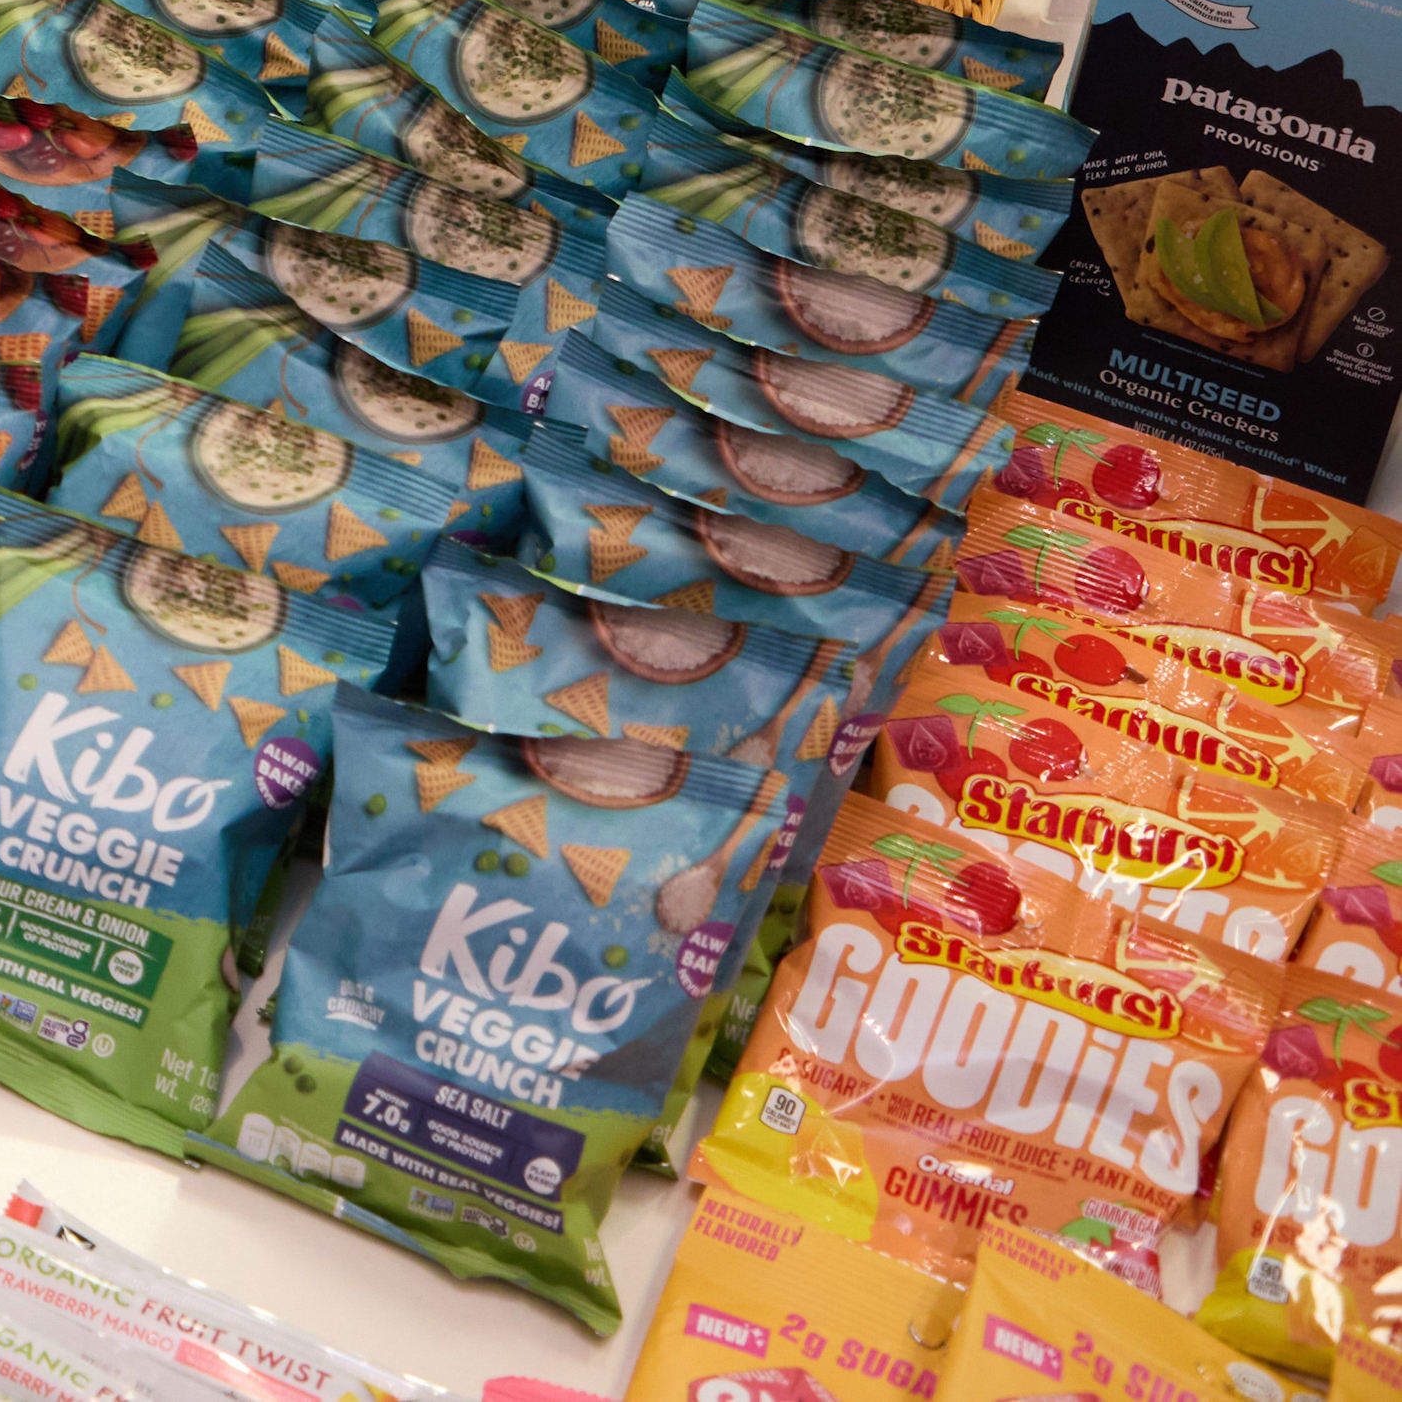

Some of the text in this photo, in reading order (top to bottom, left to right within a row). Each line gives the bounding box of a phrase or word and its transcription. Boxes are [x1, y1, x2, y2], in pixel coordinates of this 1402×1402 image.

[1160, 76, 1377, 163] patagonia
[1203, 123, 1321, 172] PROVISIONS
[1082, 158, 1108, 170] MADE
[1115, 153, 1138, 165] WITH
[1085, 168, 1107, 181] FLAX
[1111, 166, 1129, 176] AND
[1099, 369, 1280, 444] Organic Crackers
[1108, 348, 1282, 424] MULTISEED
[2, 690, 233, 834] Kibo
[961, 775, 1243, 882] Starburst
[22, 884, 82, 922] CREAM
[82, 909, 96, 927] &
[96, 914, 150, 947] ONION
[419, 883, 651, 1034] Kibo
[900, 923, 1183, 1038] Starburst
[25, 966, 67, 994] REAL
[69, 978, 144, 1023] VEGGIES!
[790, 921, 1224, 1193] GOODIES
[798, 1062, 859, 1096] SUGAR
[434, 1083, 514, 1131] SEA SALT
[773, 1093, 798, 1115] 90
[911, 1105, 1128, 1198] REAL FRUIT JUICE PLANT
[701, 1200, 802, 1249] NATURALLY
[883, 1165, 1029, 1229] GUMMIES
[694, 1216, 781, 1264] FLAVORED
[102, 1313, 177, 1356] MANGO
[140, 1297, 232, 1353] FRUIT
[236, 1337, 333, 1392] TWIST
[695, 1313, 749, 1352] NEW
